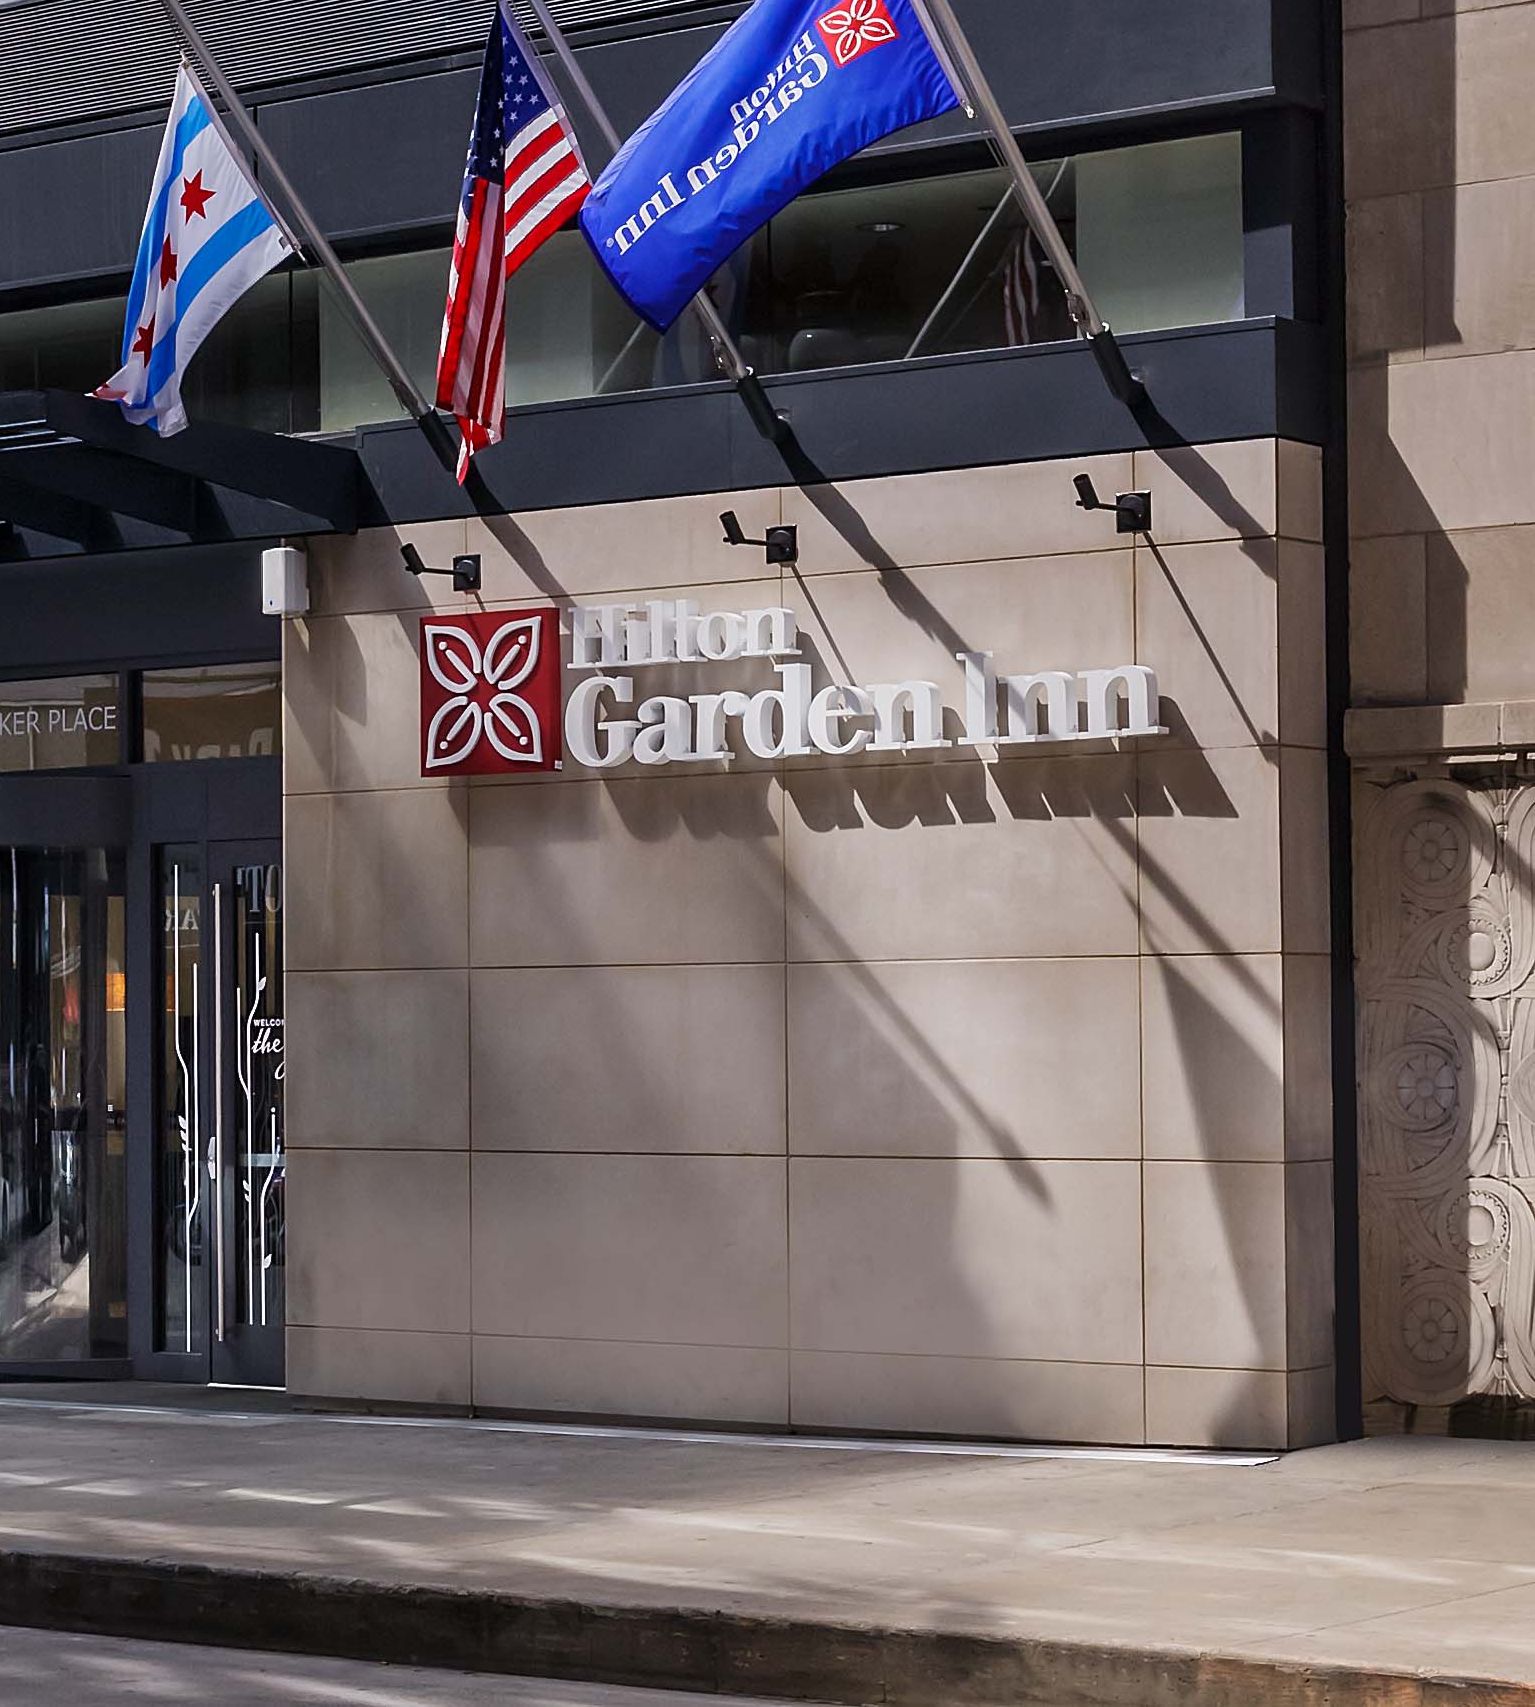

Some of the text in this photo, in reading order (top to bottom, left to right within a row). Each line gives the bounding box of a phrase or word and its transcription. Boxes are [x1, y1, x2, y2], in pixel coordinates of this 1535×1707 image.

[567, 598, 803, 669] Hilton
[49, 706, 116, 733] PLACE
[565, 650, 1170, 768] Garden Inn
[251, 1027, 285, 1054] the
